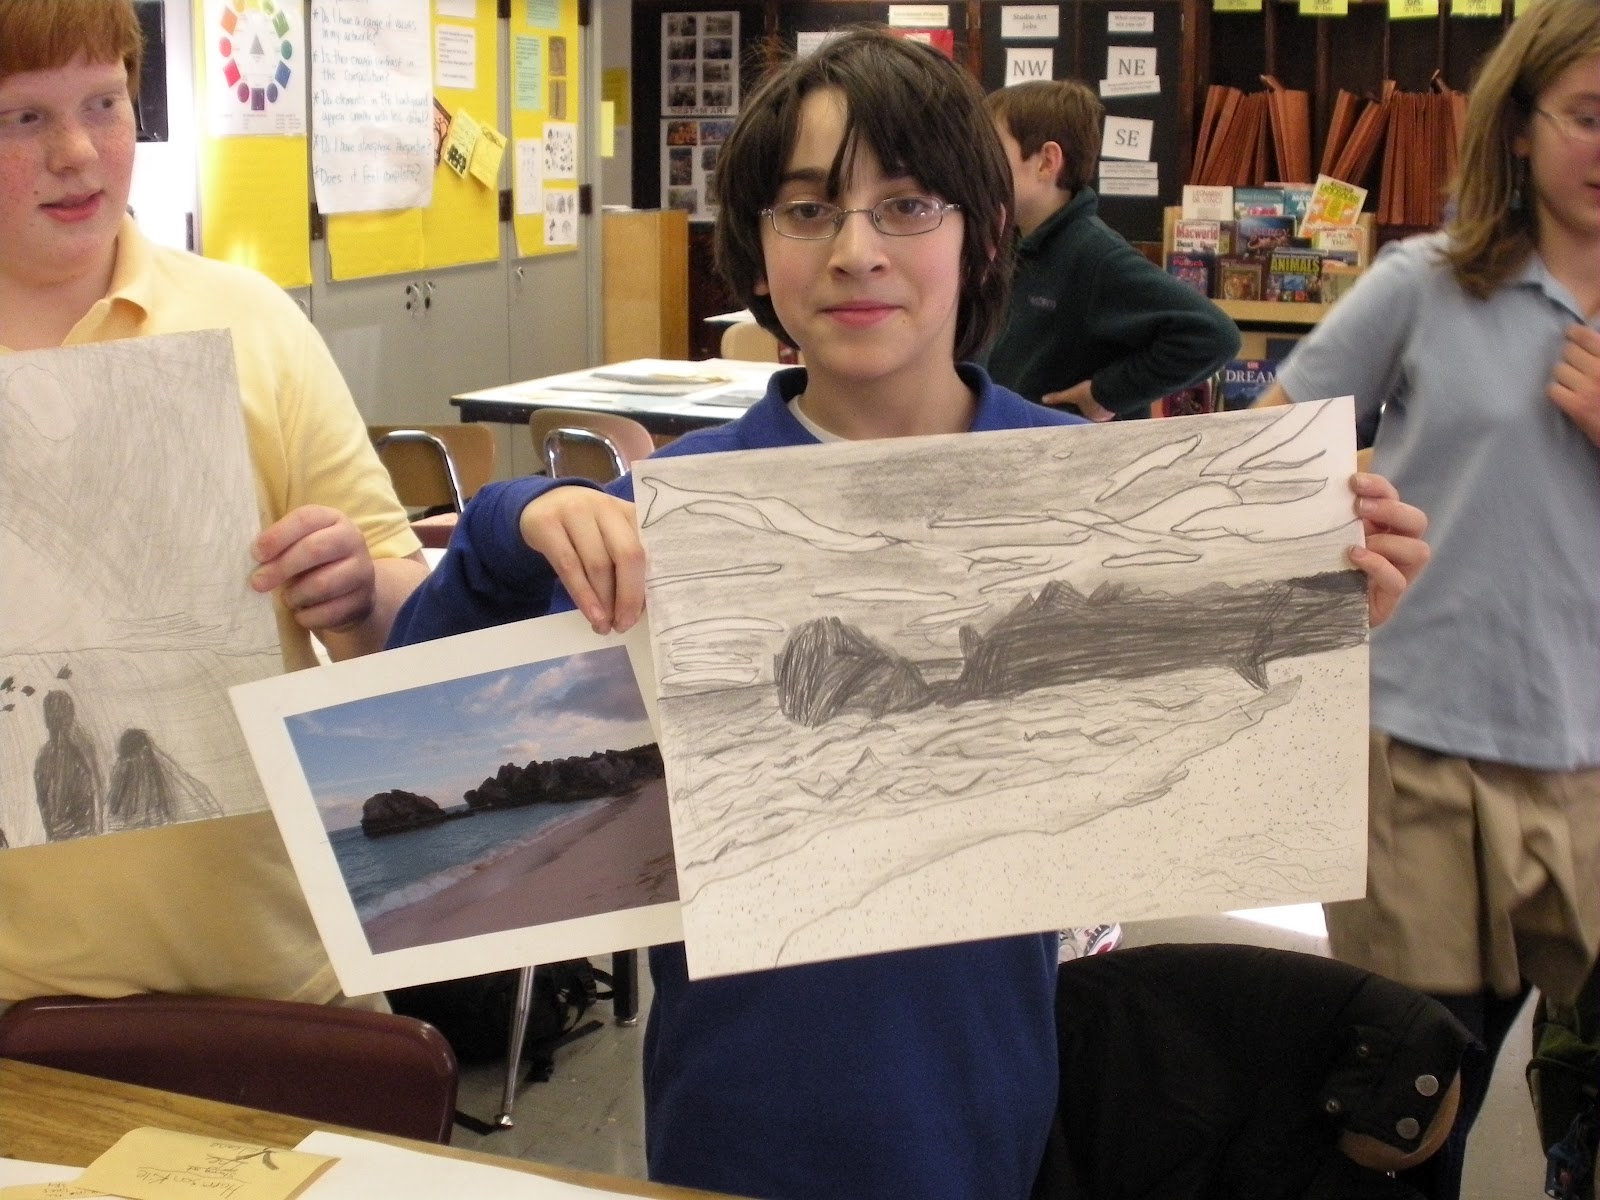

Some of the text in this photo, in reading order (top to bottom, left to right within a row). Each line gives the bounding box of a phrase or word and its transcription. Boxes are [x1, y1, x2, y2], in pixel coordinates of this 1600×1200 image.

[1013, 60, 1048, 77] NW
[1118, 58, 1146, 76] NE
[1115, 129, 1140, 147] SE
[319, 167, 343, 186] Does
[1176, 224, 1218, 240] Macworld
[1270, 257, 1320, 273] ANIMALS
